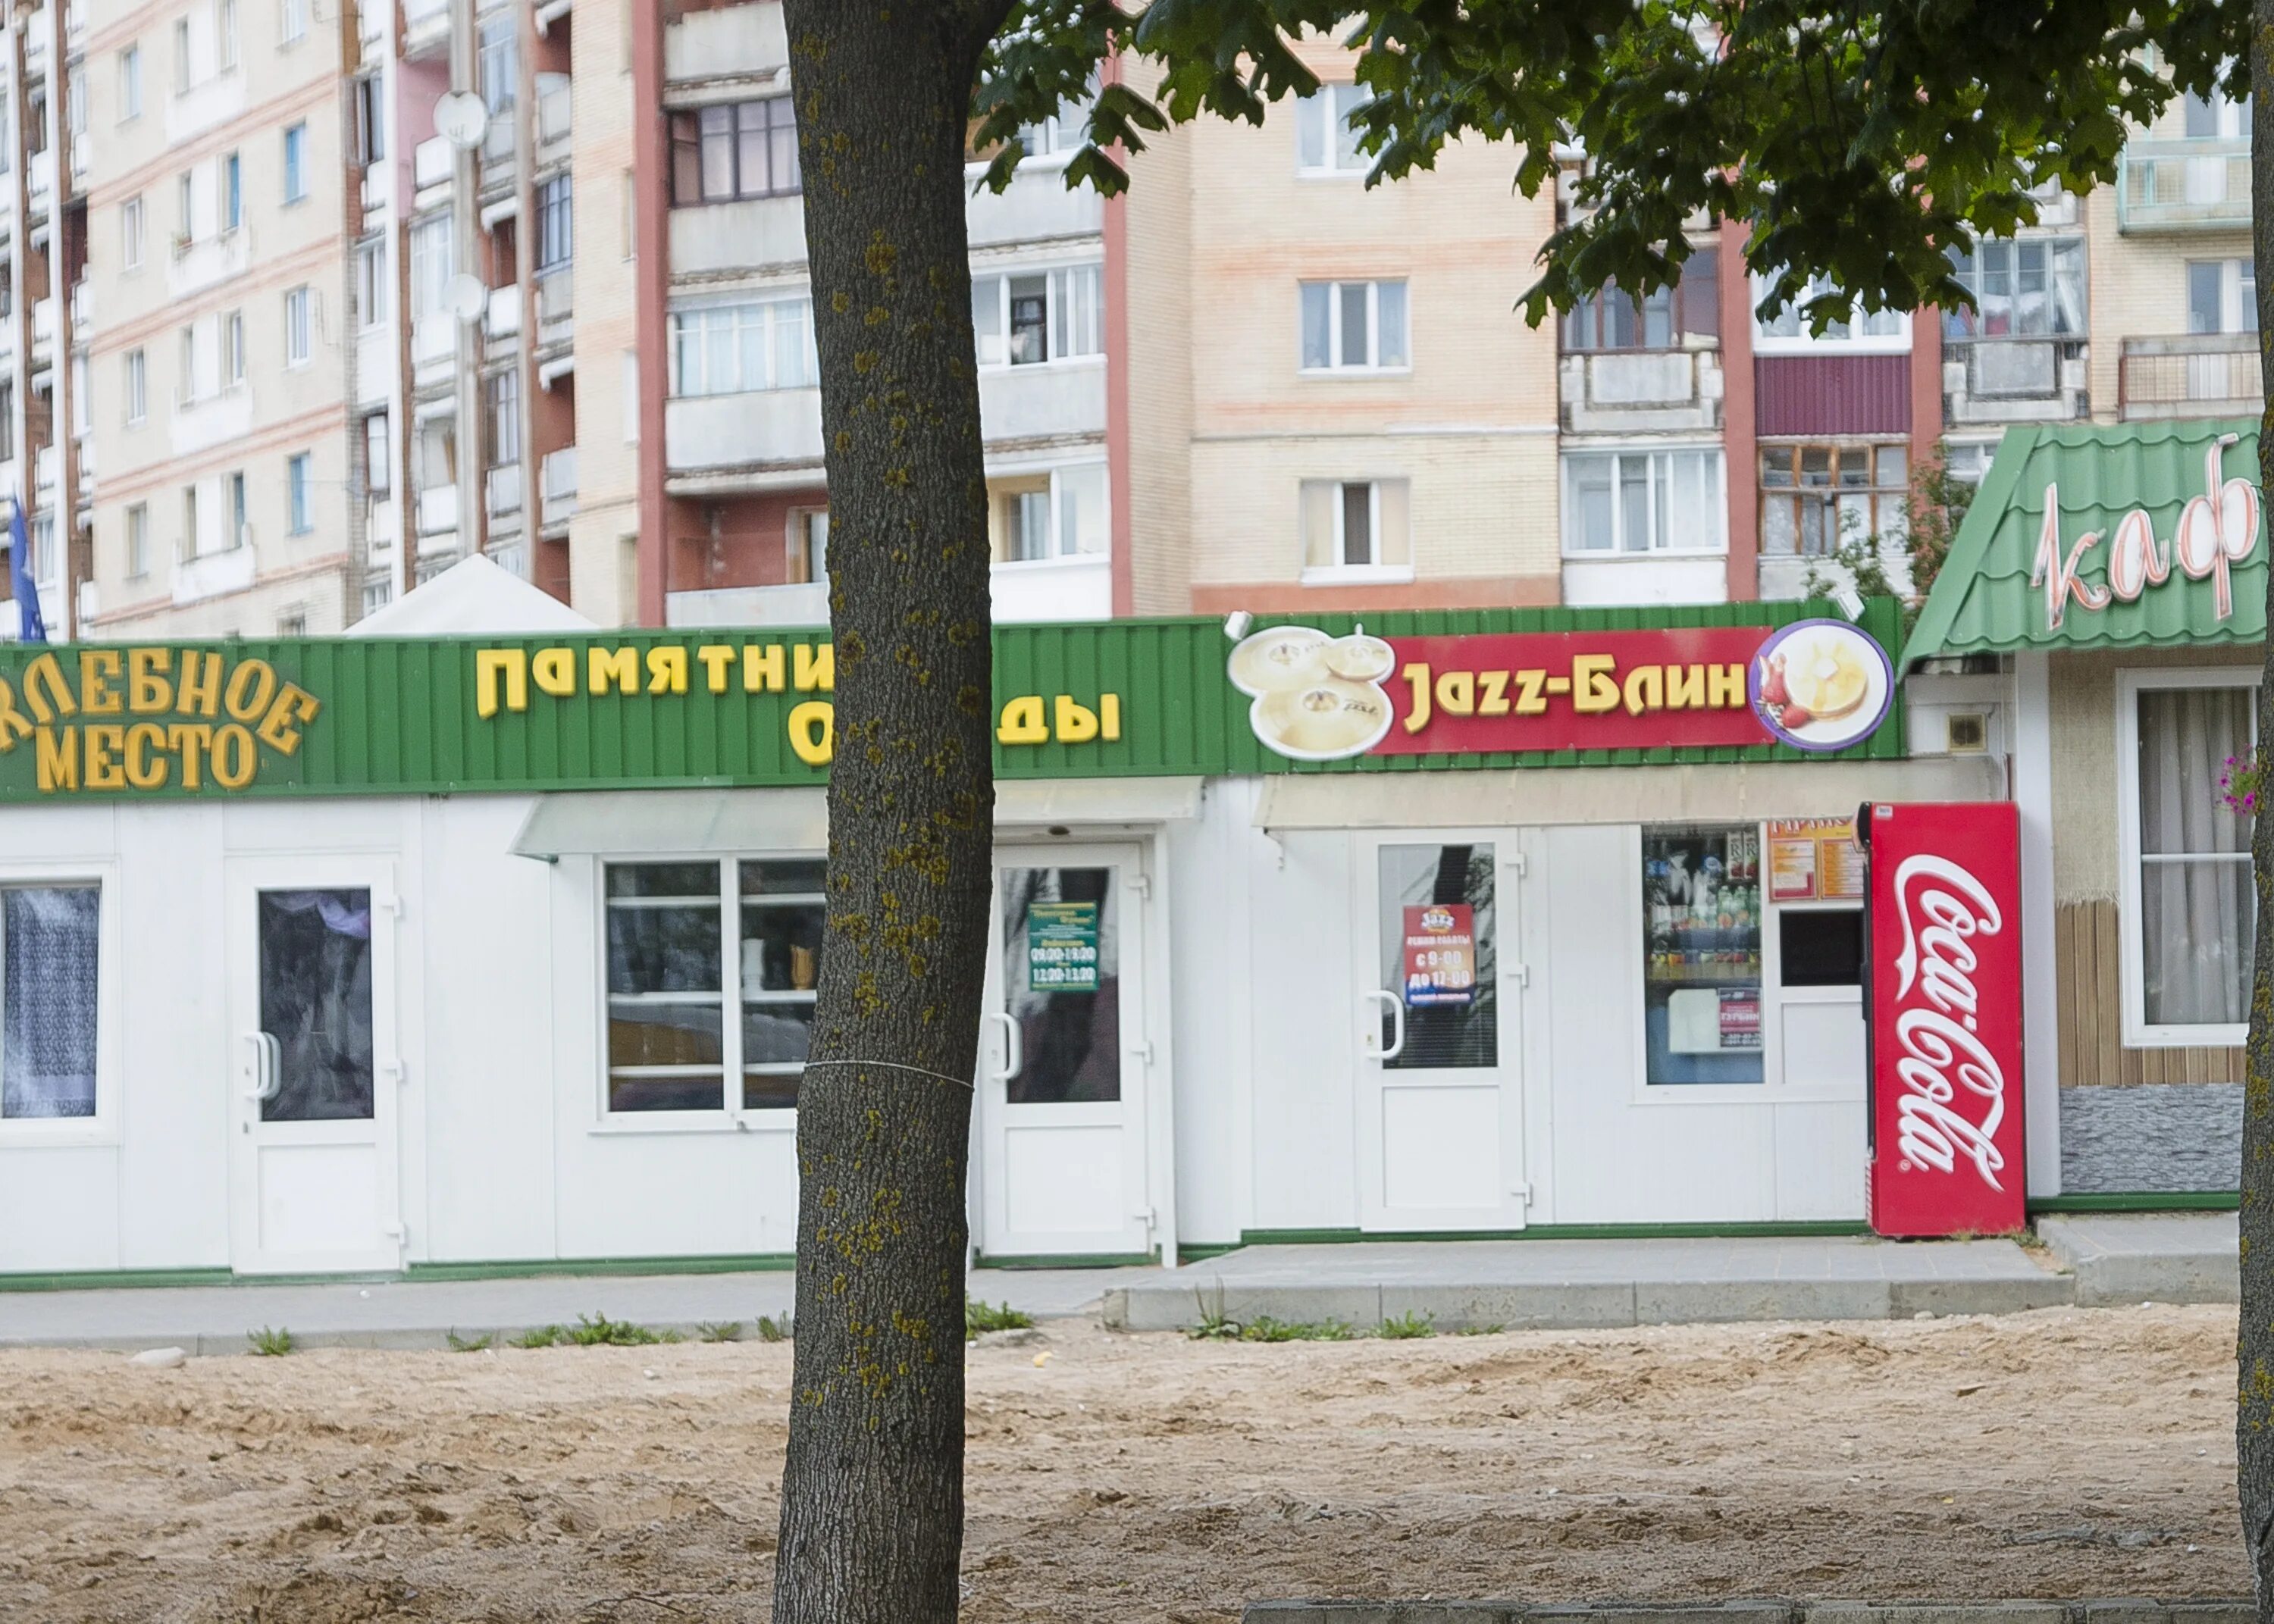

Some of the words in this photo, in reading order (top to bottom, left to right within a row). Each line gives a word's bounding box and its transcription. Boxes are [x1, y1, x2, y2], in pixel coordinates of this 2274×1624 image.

[2030, 431, 2260, 631] каф
[475, 643, 835, 719] Памятни
[1402, 653, 1746, 734] Jazz-Блин
[36, 723, 258, 791] МЕСТО
[1895, 853, 2005, 1193] Coca-Cola
